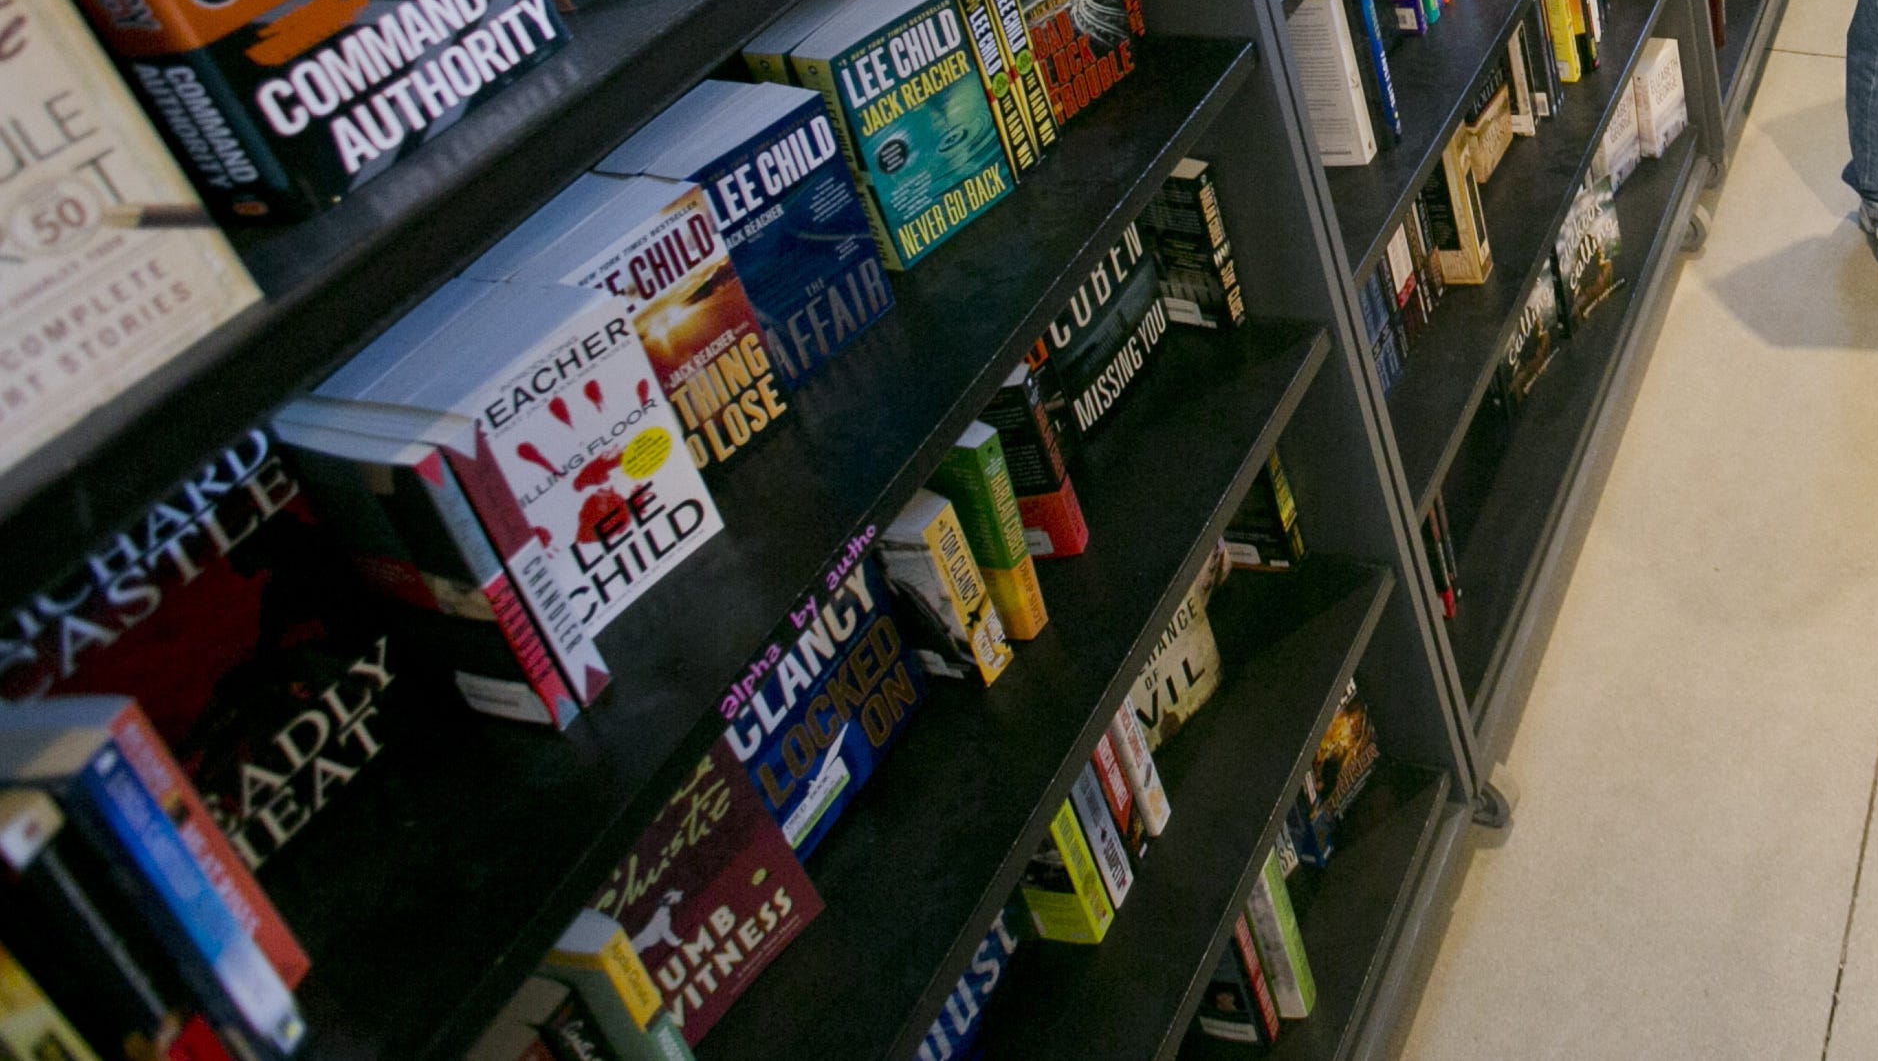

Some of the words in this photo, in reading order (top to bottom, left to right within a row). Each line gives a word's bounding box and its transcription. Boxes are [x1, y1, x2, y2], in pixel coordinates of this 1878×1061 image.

[840, 55, 893, 110] LEE
[890, 7, 963, 82] CHILD
[859, 97, 904, 138] JACK
[900, 51, 973, 110] REACHER
[165, 66, 260, 184] COMMAND
[30, 197, 88, 241] 50
[703, 178, 765, 232] LEE
[760, 114, 839, 197] CHILD
[745, 204, 786, 234] REACHER
[898, 213, 947, 261] NEVER
[945, 190, 969, 225] GO
[961, 165, 1008, 209] BACK
[633, 209, 717, 302] CHILD
[61, 283, 193, 377] STORIES
[767, 256, 891, 381] AFFAIR
[1074, 337, 1143, 430] MISSING
[1140, 300, 1169, 354] YOU
[584, 395, 660, 461] FLOOR
[715, 387, 788, 466] LOSE
[574, 478, 671, 570] LEE
[521, 556, 586, 655] CHANDLER
[718, 642, 783, 720] alpha
[724, 562, 881, 763] CLANCY
[861, 662, 917, 748] ON
[758, 613, 902, 809] LOCKED
